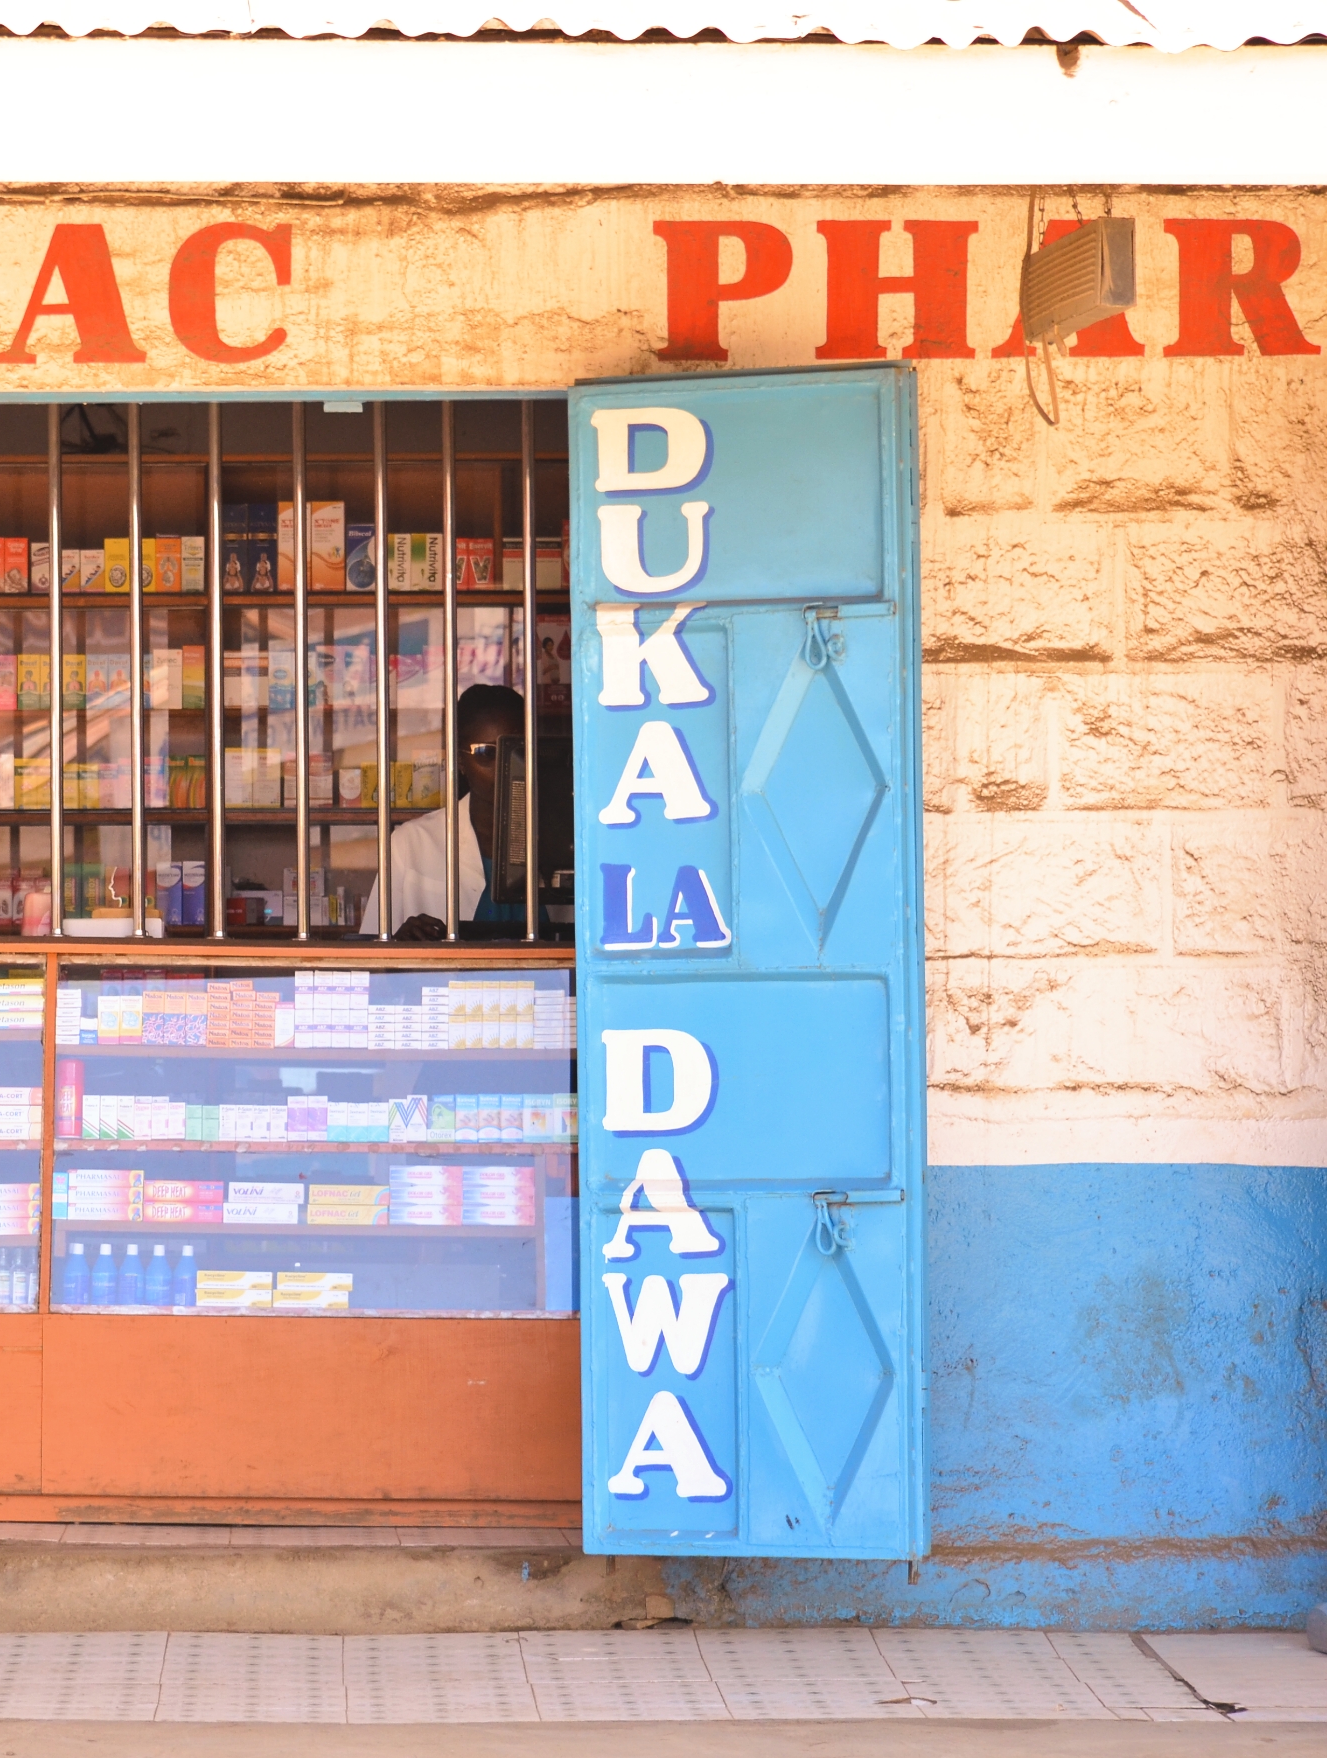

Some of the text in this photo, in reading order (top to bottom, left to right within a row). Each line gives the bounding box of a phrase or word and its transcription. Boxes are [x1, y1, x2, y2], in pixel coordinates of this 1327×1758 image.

[591, 406, 733, 1502] DUKA LA DAWA
[152, 1184, 187, 1198] DEEP HEAT
[151, 1205, 187, 1218] DEEP HEAT
